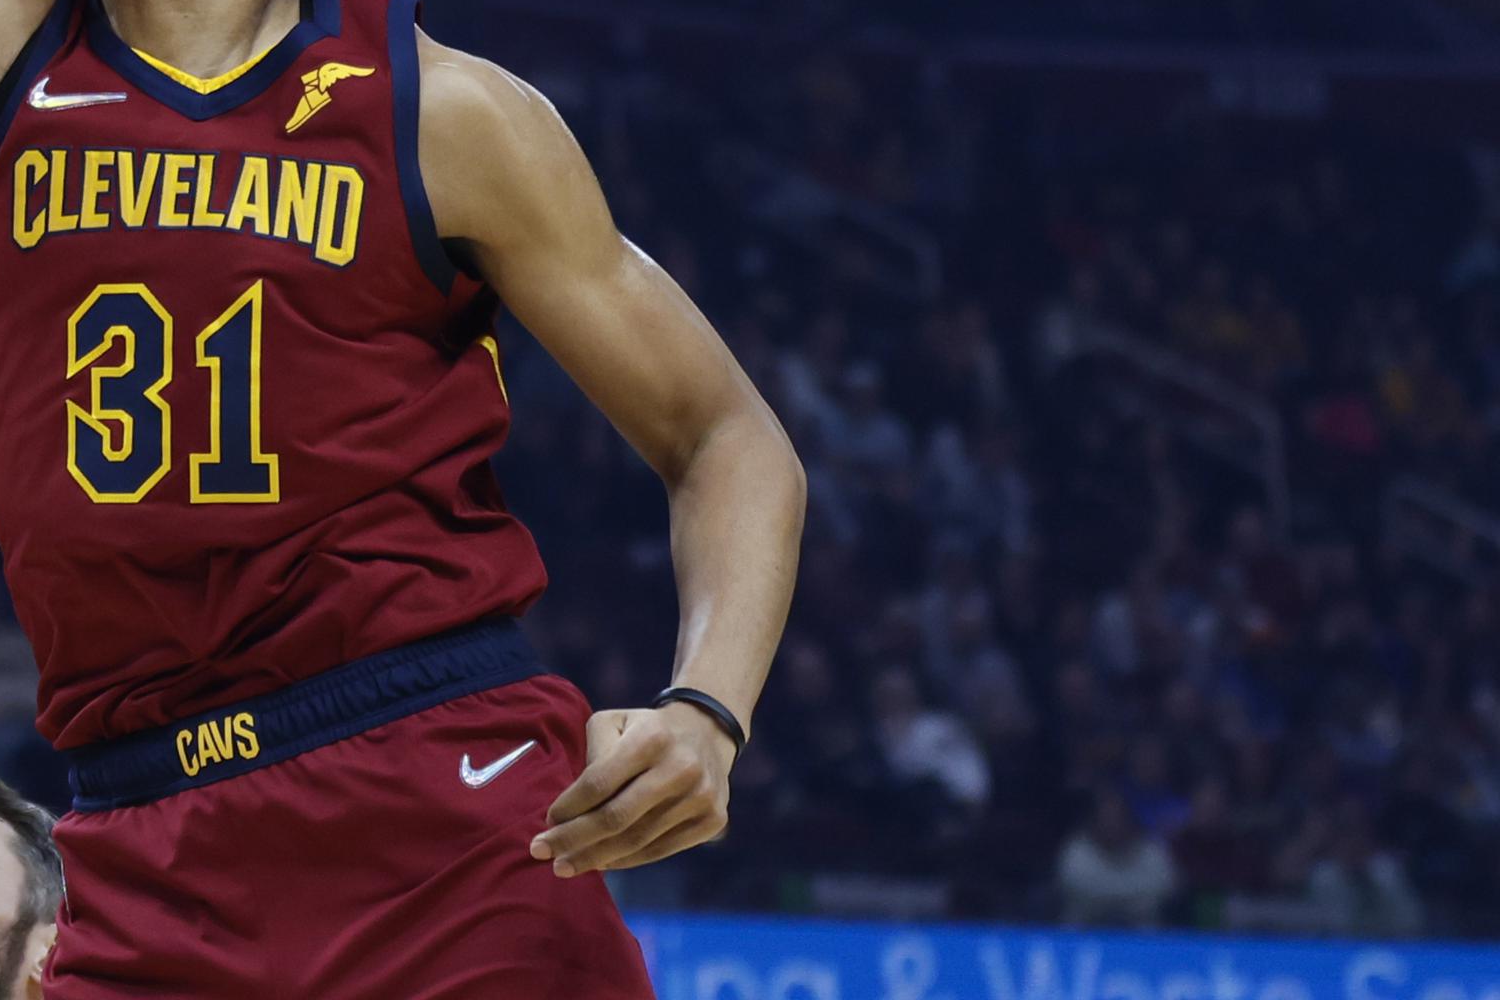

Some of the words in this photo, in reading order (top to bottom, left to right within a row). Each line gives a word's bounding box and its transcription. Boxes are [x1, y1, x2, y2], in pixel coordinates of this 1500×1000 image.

[11, 148, 366, 268] CLEVELAND
[65, 279, 281, 504] 31
[174, 711, 261, 778] CAVS
